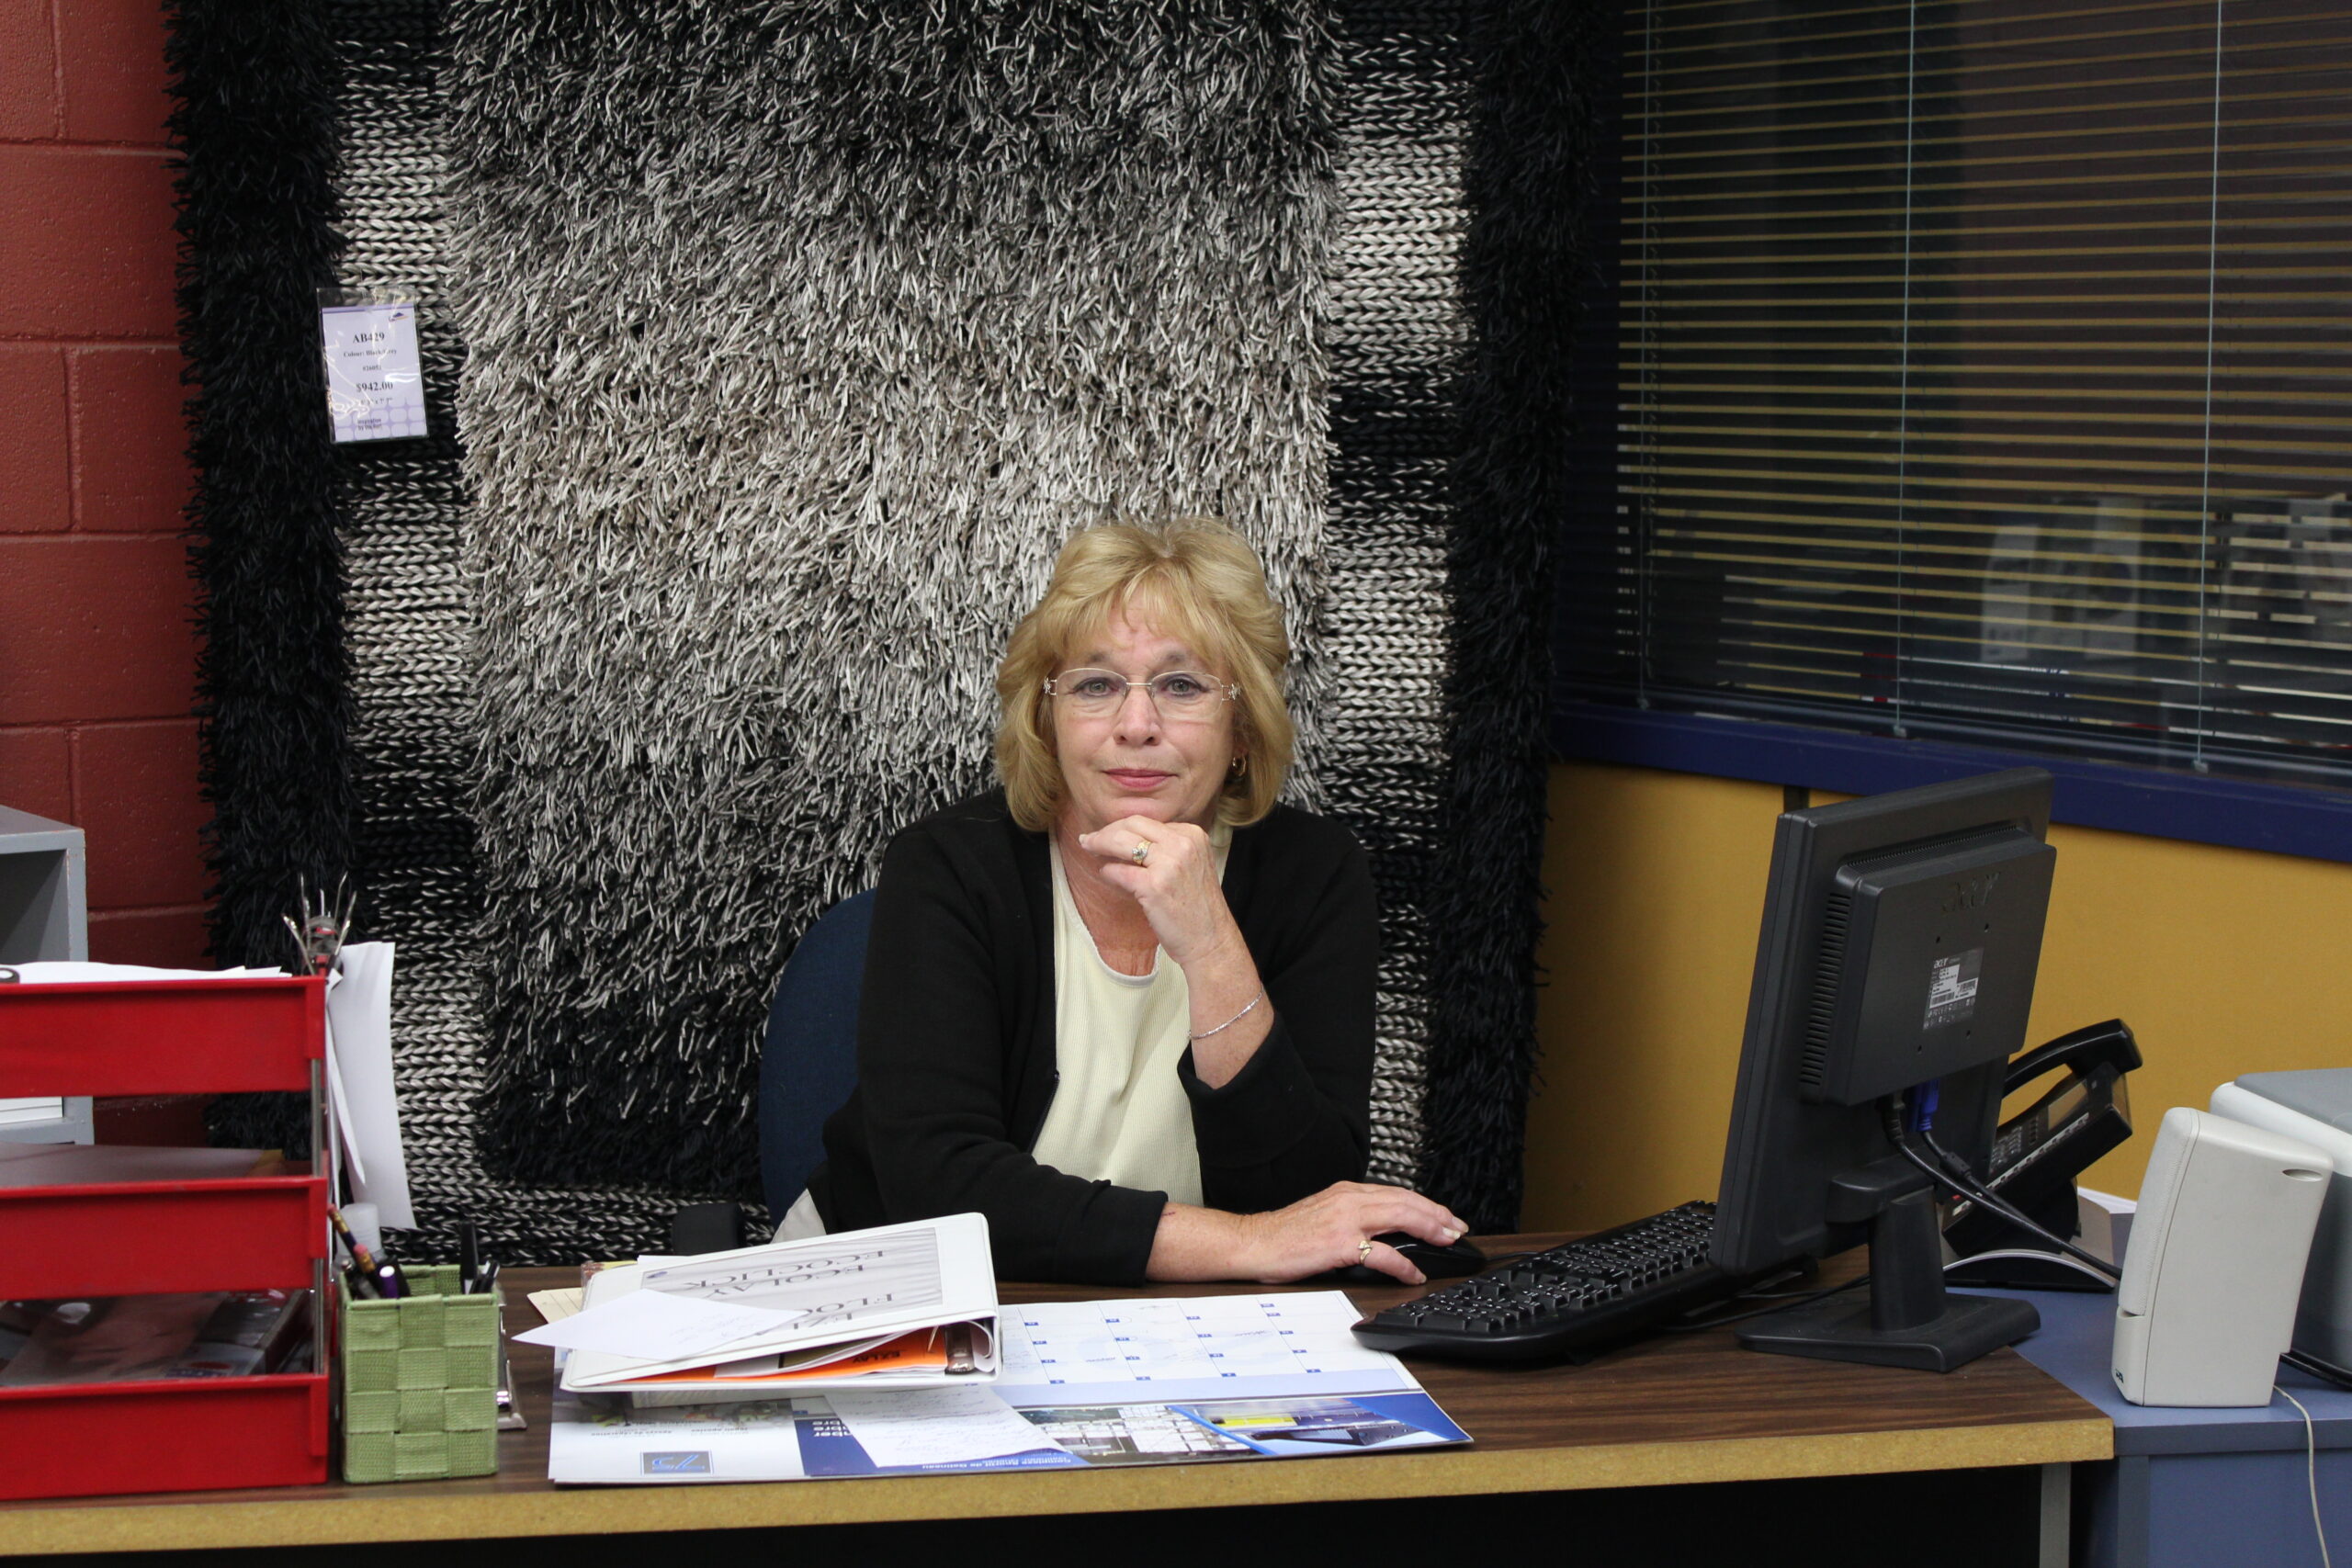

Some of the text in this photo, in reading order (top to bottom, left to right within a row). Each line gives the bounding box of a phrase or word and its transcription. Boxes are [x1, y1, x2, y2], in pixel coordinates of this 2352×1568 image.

[353, 332, 385, 344] AB429
[356, 381, 393, 393] $942.00
[684, 1250, 883, 1287] ECOCLICK
[703, 1264, 864, 1299] ECOLAY
